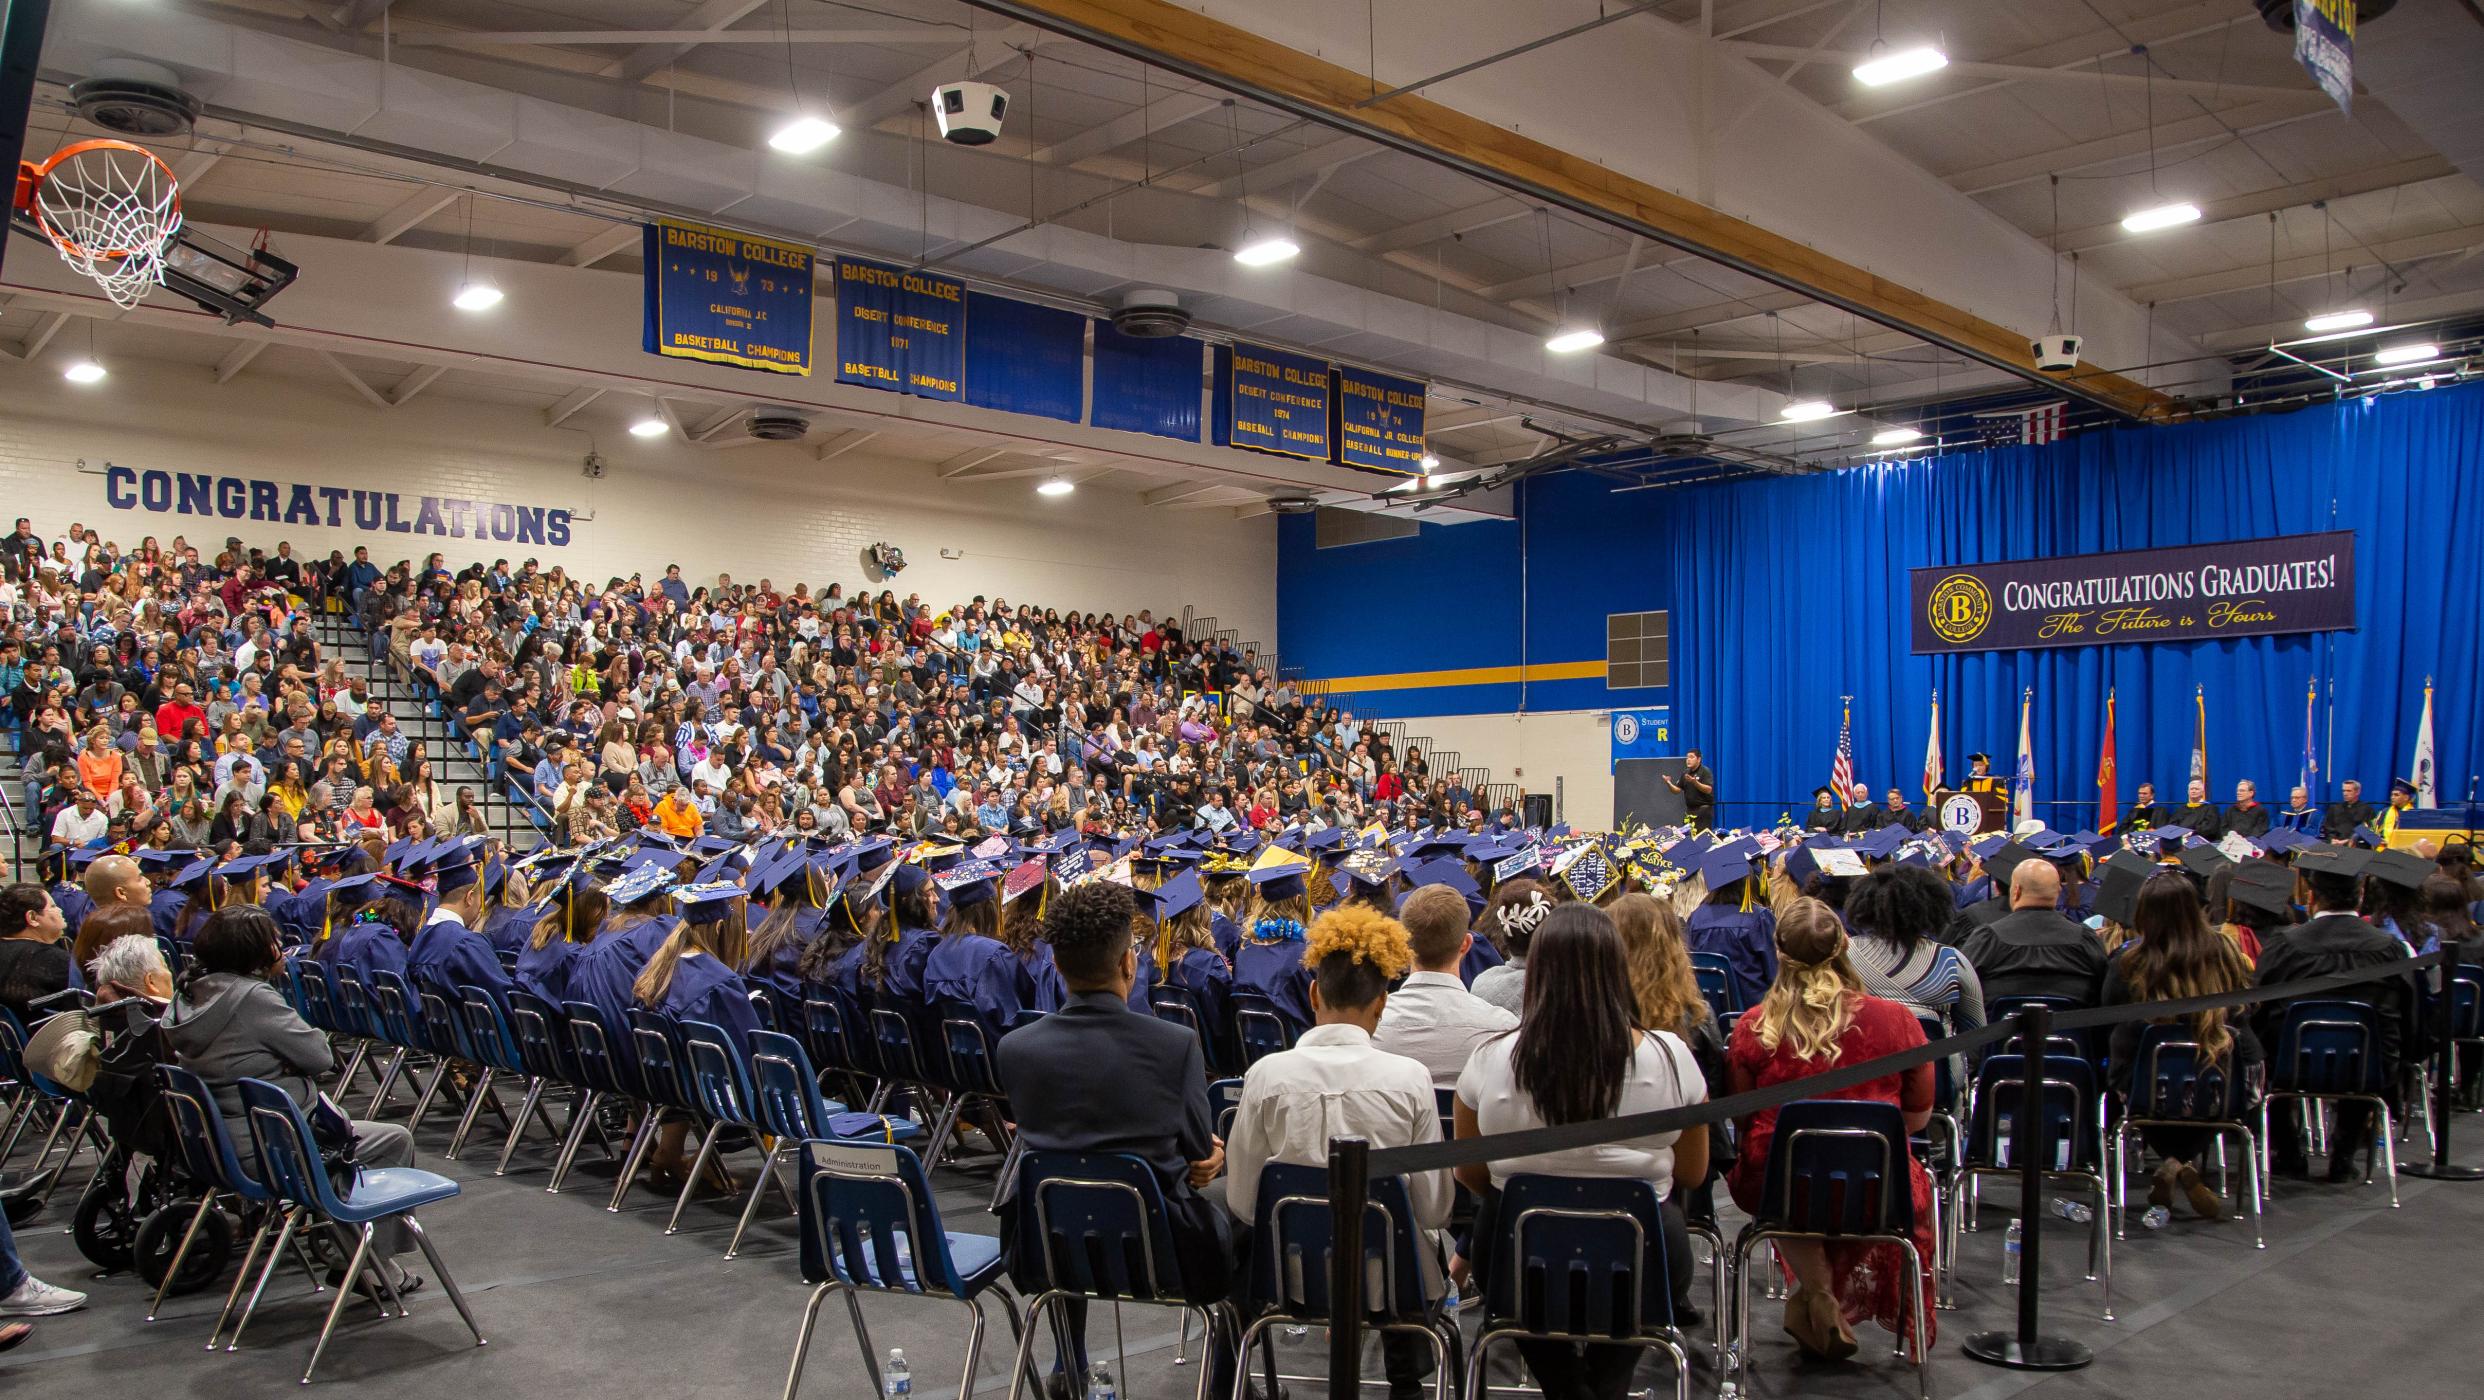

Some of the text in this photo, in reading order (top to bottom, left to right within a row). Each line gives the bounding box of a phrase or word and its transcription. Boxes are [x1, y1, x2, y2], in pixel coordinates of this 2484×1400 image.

[667, 228, 807, 271] BARSTOW COLLEGE
[705, 269, 718, 283] 19
[842, 263, 961, 302] BARSTOW COLLEGE
[710, 303, 752, 319] CALIFORNIA
[894, 314, 948, 335] CONFERENCE
[674, 333, 800, 363] BASKETBALL CHAMPIONS
[910, 373, 957, 392] CHAMPIONS
[1235, 356, 1327, 389] BARSTOW COLLEGE
[1239, 384, 1322, 409] DESERT CONFERENCE
[1343, 379, 1423, 409] BARSTOW COLLEGE
[1274, 408, 1290, 420] 1974
[1237, 420, 1324, 444] BASEBALL CHAMPIONS
[1344, 422, 1380, 438] CALIFORNIA
[1397, 432, 1423, 445] COLLEGE
[1345, 439, 1382, 456] BASEBALL
[106, 466, 571, 547] CONGRATULATIONS
[2003, 554, 2336, 612] CONGRATULATIONS GRADUATES!
[1951, 595, 1972, 622] B
[2038, 600, 2277, 639] The Future is Yours
[1657, 727, 1668, 742] R
[1956, 807, 1970, 825] B
[821, 1156, 881, 1171] Administration
